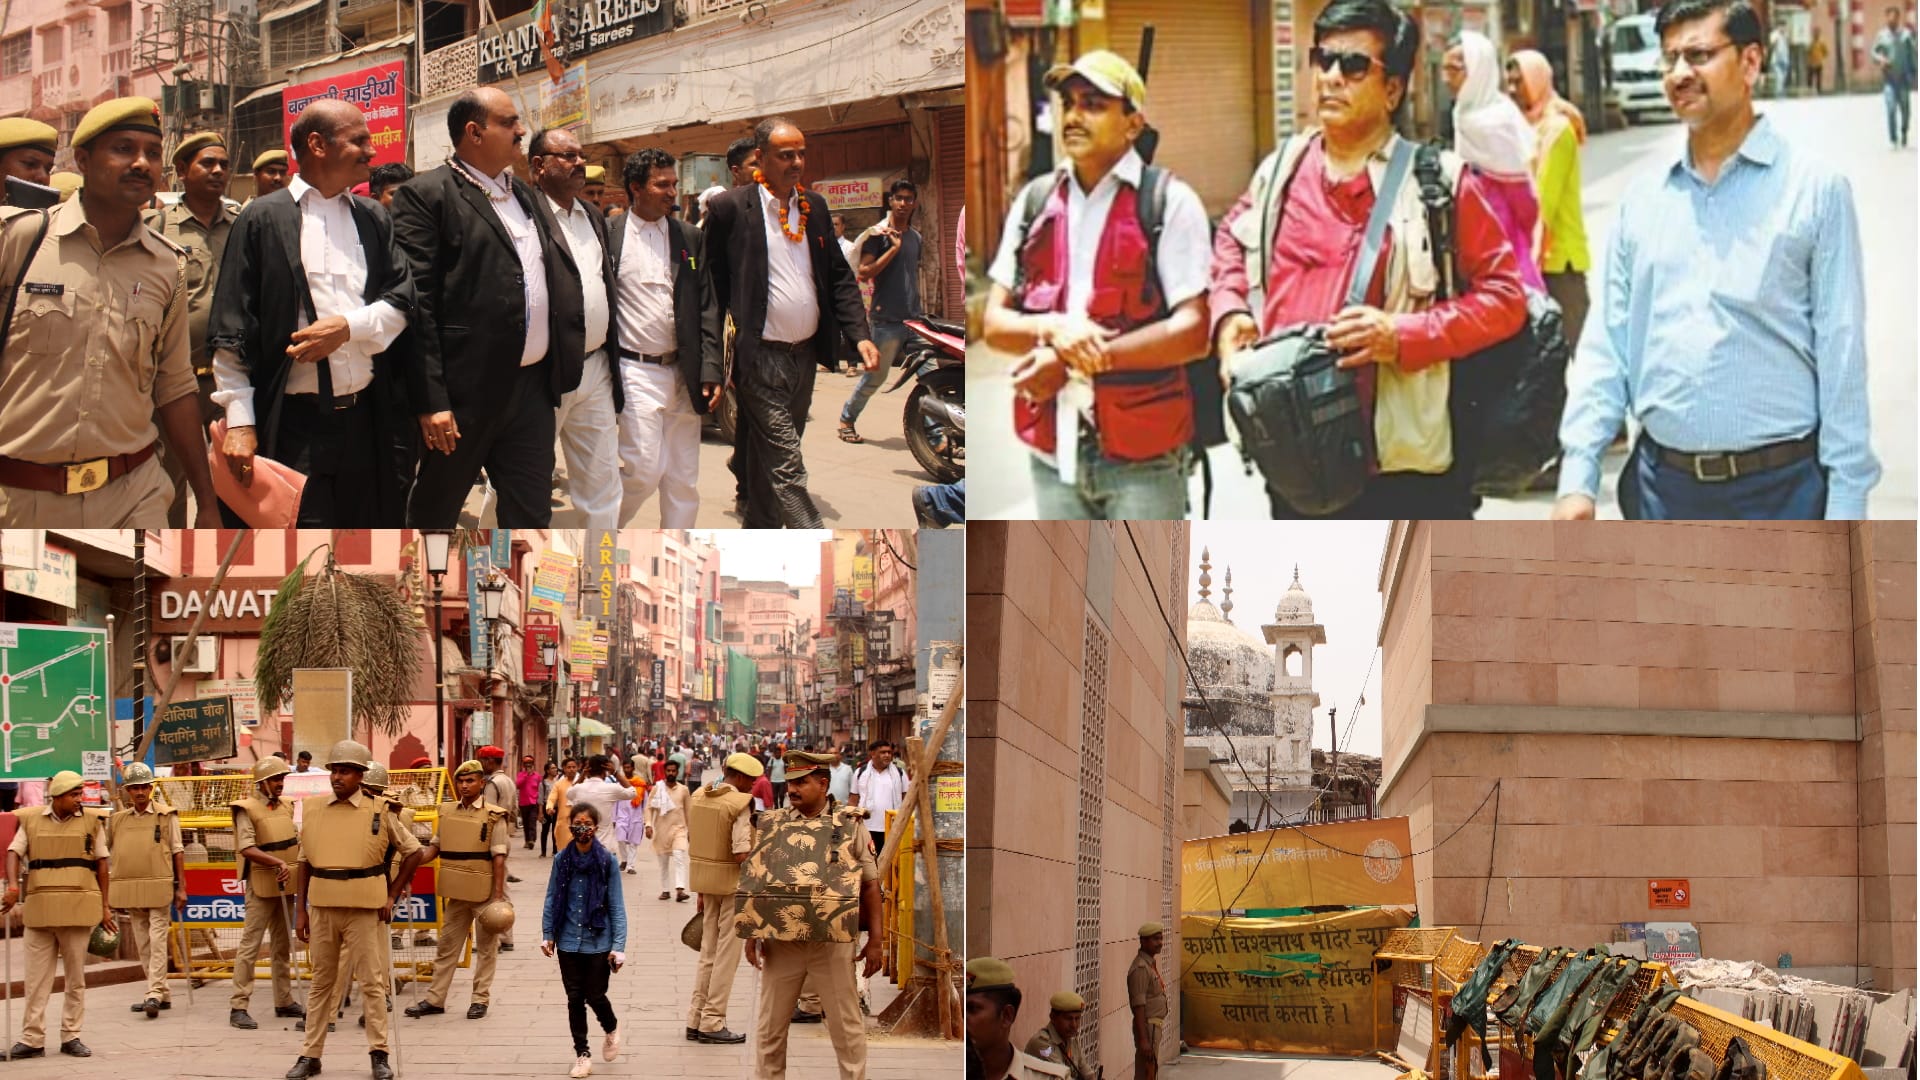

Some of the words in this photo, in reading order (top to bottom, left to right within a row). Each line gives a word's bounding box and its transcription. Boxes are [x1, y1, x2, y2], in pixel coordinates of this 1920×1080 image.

[590, 24, 634, 47] Sarees
[828, 181, 869, 194] महादेव
[599, 531, 614, 616] ARASI
[161, 589, 279, 619] DAWAT
[202, 702, 225, 717] चौक
[1182, 929, 1226, 954] काशी
[1231, 930, 1305, 953] विश्वनाथ
[1309, 924, 1351, 949] मंदिर
[1274, 1005, 1318, 1024] करता
[1321, 997, 1335, 1028] है
